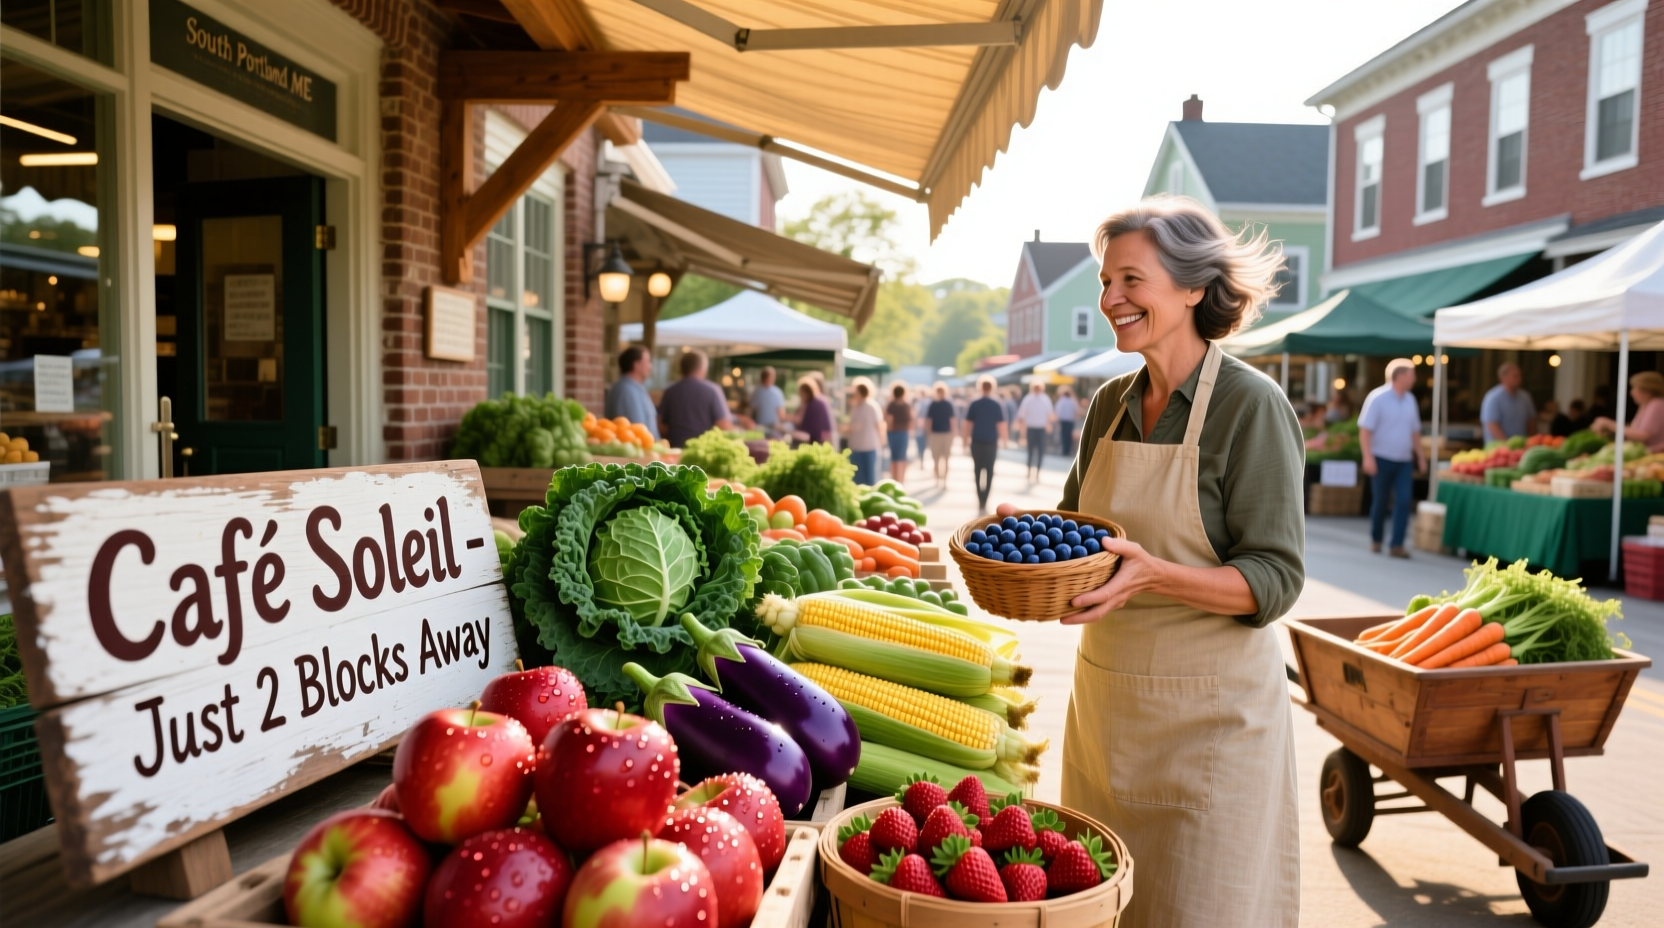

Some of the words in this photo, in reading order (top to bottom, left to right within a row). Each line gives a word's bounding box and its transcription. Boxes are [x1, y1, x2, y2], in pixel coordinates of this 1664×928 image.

[186, 16, 233, 62] South
[290, 71, 313, 102] ME
[87, 518, 291, 666] Café
[305, 495, 462, 612] Soleil
[133, 683, 245, 778] Just
[256, 666, 287, 733] 2
[293, 633, 409, 718] Blocks
[419, 616, 490, 675] Away
